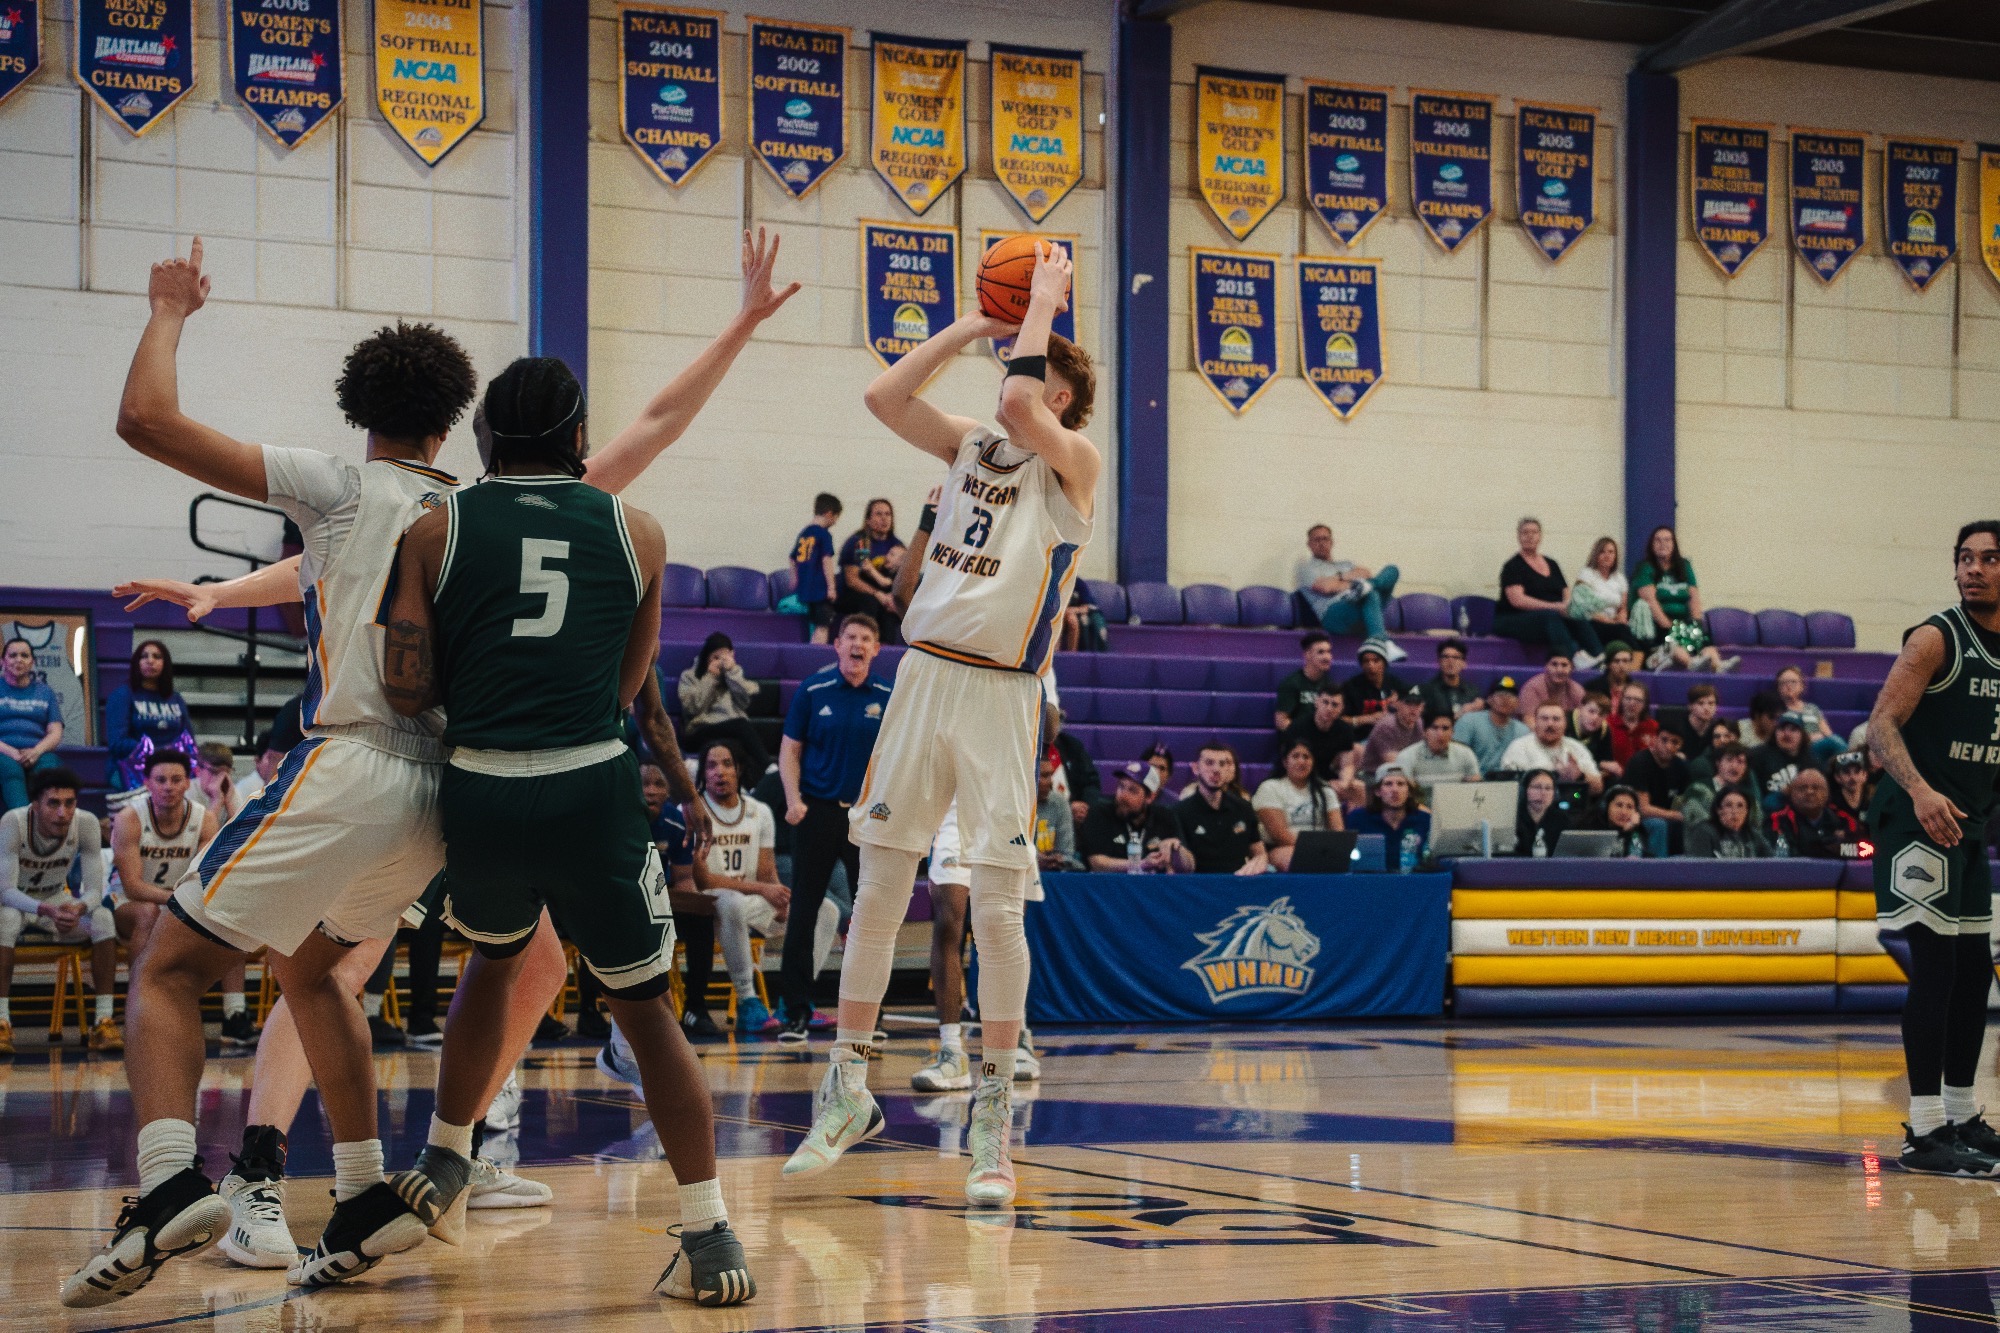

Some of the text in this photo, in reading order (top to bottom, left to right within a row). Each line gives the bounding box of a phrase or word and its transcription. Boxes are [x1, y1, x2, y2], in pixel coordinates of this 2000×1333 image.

[105, 0, 167, 15] MEN'S
[108, 12, 164, 30] GOLF
[241, 11, 331, 34] WOMEN'S
[630, 17, 711, 38] NCAA DII
[261, 29, 313, 47] GOLF
[380, 34, 476, 57] SOFTBALL
[759, 31, 838, 54] NCAA DII
[649, 41, 694, 59] 2004
[881, 47, 959, 70] NCAA DII
[393, 58, 458, 84] NCAA
[628, 61, 716, 83] SOFTBALL
[777, 55, 820, 74] 2002
[1000, 58, 1073, 79] NCAA DII
[91, 70, 181, 94] CHAMPS
[754, 75, 840, 98] SOFTBALL
[1206, 80, 1276, 102] NCAA DII
[244, 87, 331, 109] CHAMPS
[382, 88, 476, 111] REGIONAL
[883, 91, 955, 110] WOMEN'S
[1314, 92, 1382, 112] NCAA DII
[391, 106, 466, 124] CHAMPS
[898, 107, 941, 122] GOLF
[1001, 99, 1073, 119] WOMEN'S
[1419, 101, 1461, 118] NCAA
[1017, 116, 1057, 131] GOLF
[1206, 121, 1275, 141] WOMEN'S
[1524, 112, 1564, 131] NCAA
[634, 128, 711, 149] CHAMPS
[891, 125, 945, 148] NCAA
[1010, 133, 1063, 156] NCAA
[1222, 137, 1261, 152] GOLF
[1310, 133, 1383, 152] SOFTBALL
[1700, 131, 1739, 146] NCAA
[760, 141, 834, 163] CHAMPS
[1797, 138, 1836, 155] NCAA
[880, 149, 956, 168] REGIONAL
[1000, 157, 1075, 175] REGIONAL
[1214, 155, 1266, 176] NCAA
[1524, 148, 1589, 168] WOMEN'S
[887, 165, 949, 181] CHAMPS
[1006, 172, 1066, 188] CHAMPS
[1536, 164, 1575, 179] GOLF
[1905, 166, 1939, 180] 2007
[1205, 178, 1274, 195] REGIONAL
[1211, 192, 1267, 208] CHAMPS
[1314, 193, 1379, 212] CHAMPS
[1419, 201, 1483, 219] CHAMPS
[1523, 212, 1585, 231] CHAMPS
[872, 231, 949, 253] NCAA DII
[1701, 227, 1760, 244] CHAMPS
[1797, 234, 1856, 252] CHAMPS
[1892, 241, 1949, 258] CHAMPS
[889, 254, 931, 272] 2016
[1201, 258, 1270, 279] NCAA DII
[885, 272, 936, 289] MEN'S
[1304, 266, 1372, 284] NCAA DII
[880, 286, 940, 304] TENNIS
[1216, 279, 1255, 296] 2015
[1319, 286, 1358, 302] 2017
[1213, 297, 1259, 313] MEN'S
[1317, 304, 1362, 319] MEN'S
[1208, 310, 1263, 327] TENNIS
[1320, 318, 1362, 332] GOLF
[1203, 360, 1270, 379] CHAMPS
[1310, 367, 1375, 384] CHAMPS
[929, 542, 964, 570] NEW
[511, 537, 571, 638] 5
[1969, 677, 2000, 698] EAS
[1948, 741, 1984, 762] NEW
[140, 846, 191, 859] WESTERN
[722, 849, 742, 871] 30
[29, 871, 44, 886] 4
[154, 863, 169, 884] 2
[1506, 929, 1801, 946] WESTERN NEW MEXICO UNIVERSITY
[1203, 958, 1304, 993] WNMU
